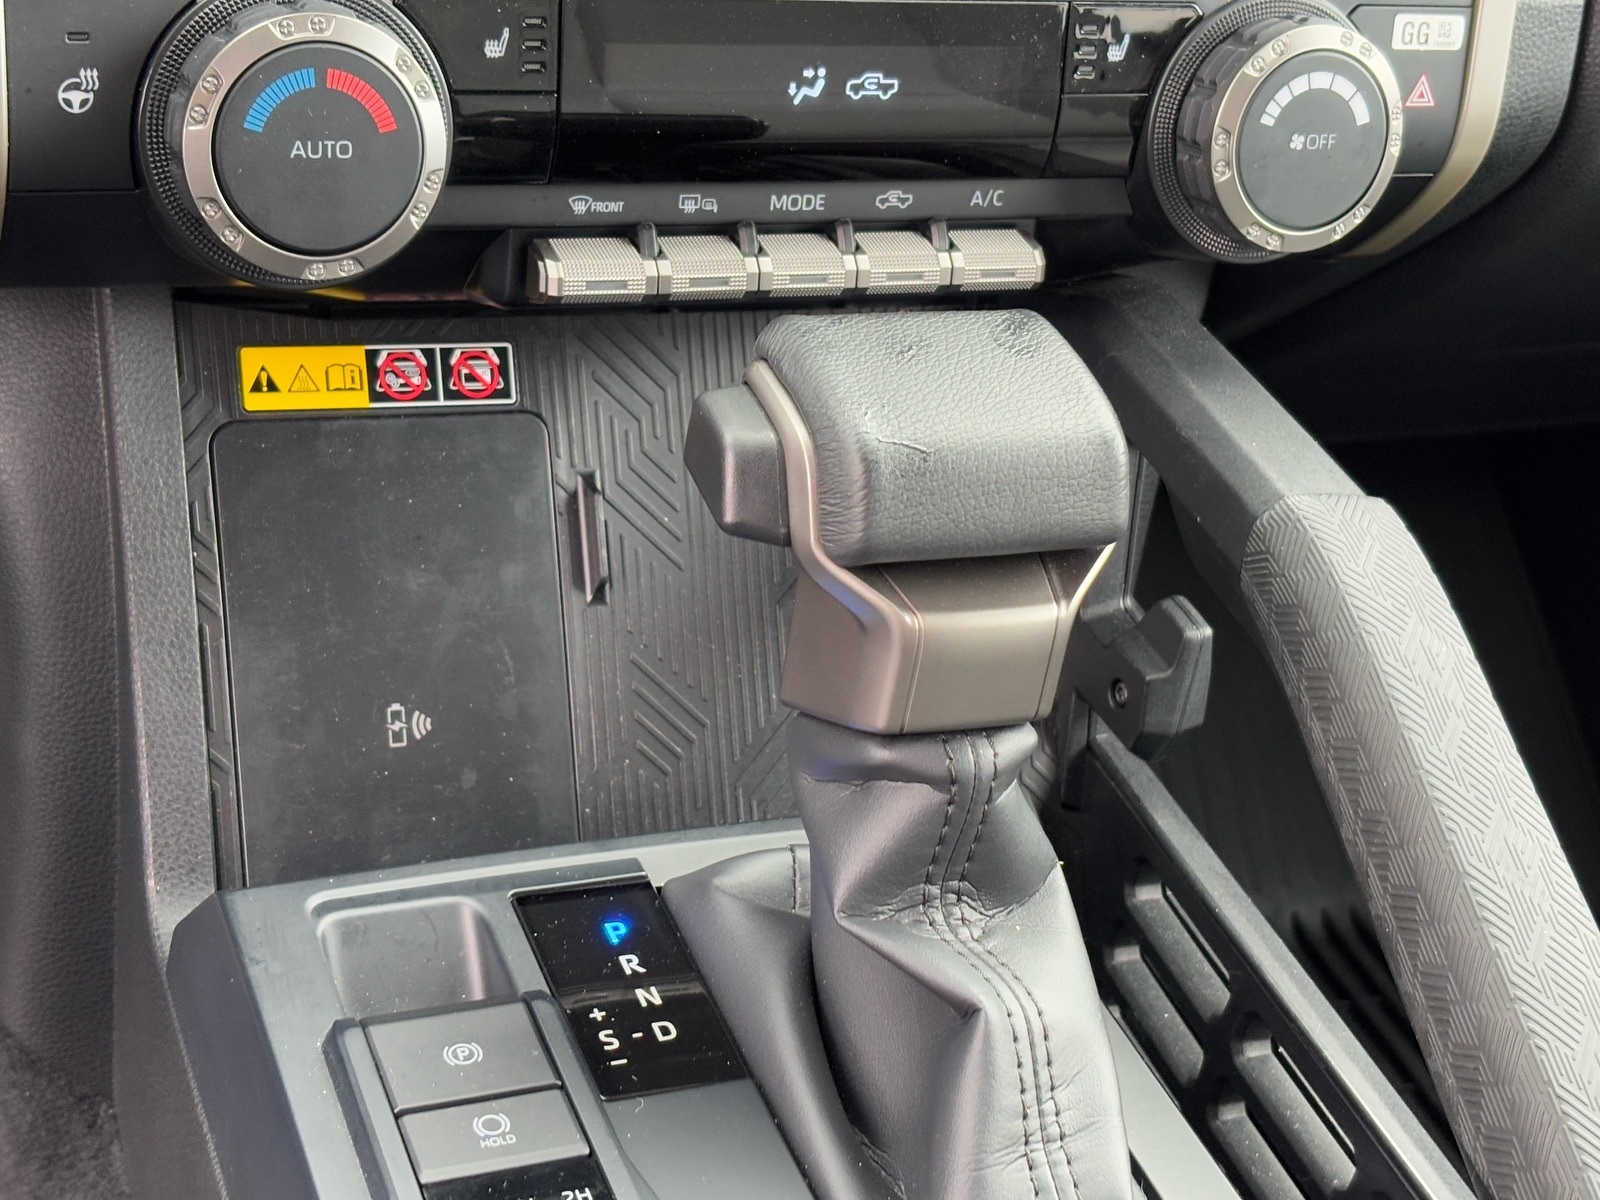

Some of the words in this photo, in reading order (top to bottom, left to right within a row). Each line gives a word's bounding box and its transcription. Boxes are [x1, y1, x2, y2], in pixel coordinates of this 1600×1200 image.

[1401, 21, 1430, 46] GG
[290, 140, 353, 159] AUTO
[1306, 134, 1337, 150] OFF
[591, 201, 625, 213] FRONT
[770, 194, 826, 211] MODE
[970, 189, 1004, 207] A/C
[603, 921, 628, 946] P
[618, 954, 647, 975] R
[634, 986, 663, 1008] N
[598, 1029, 620, 1051] S
[651, 1020, 678, 1042] D
[480, 1134, 517, 1148] HOLD
